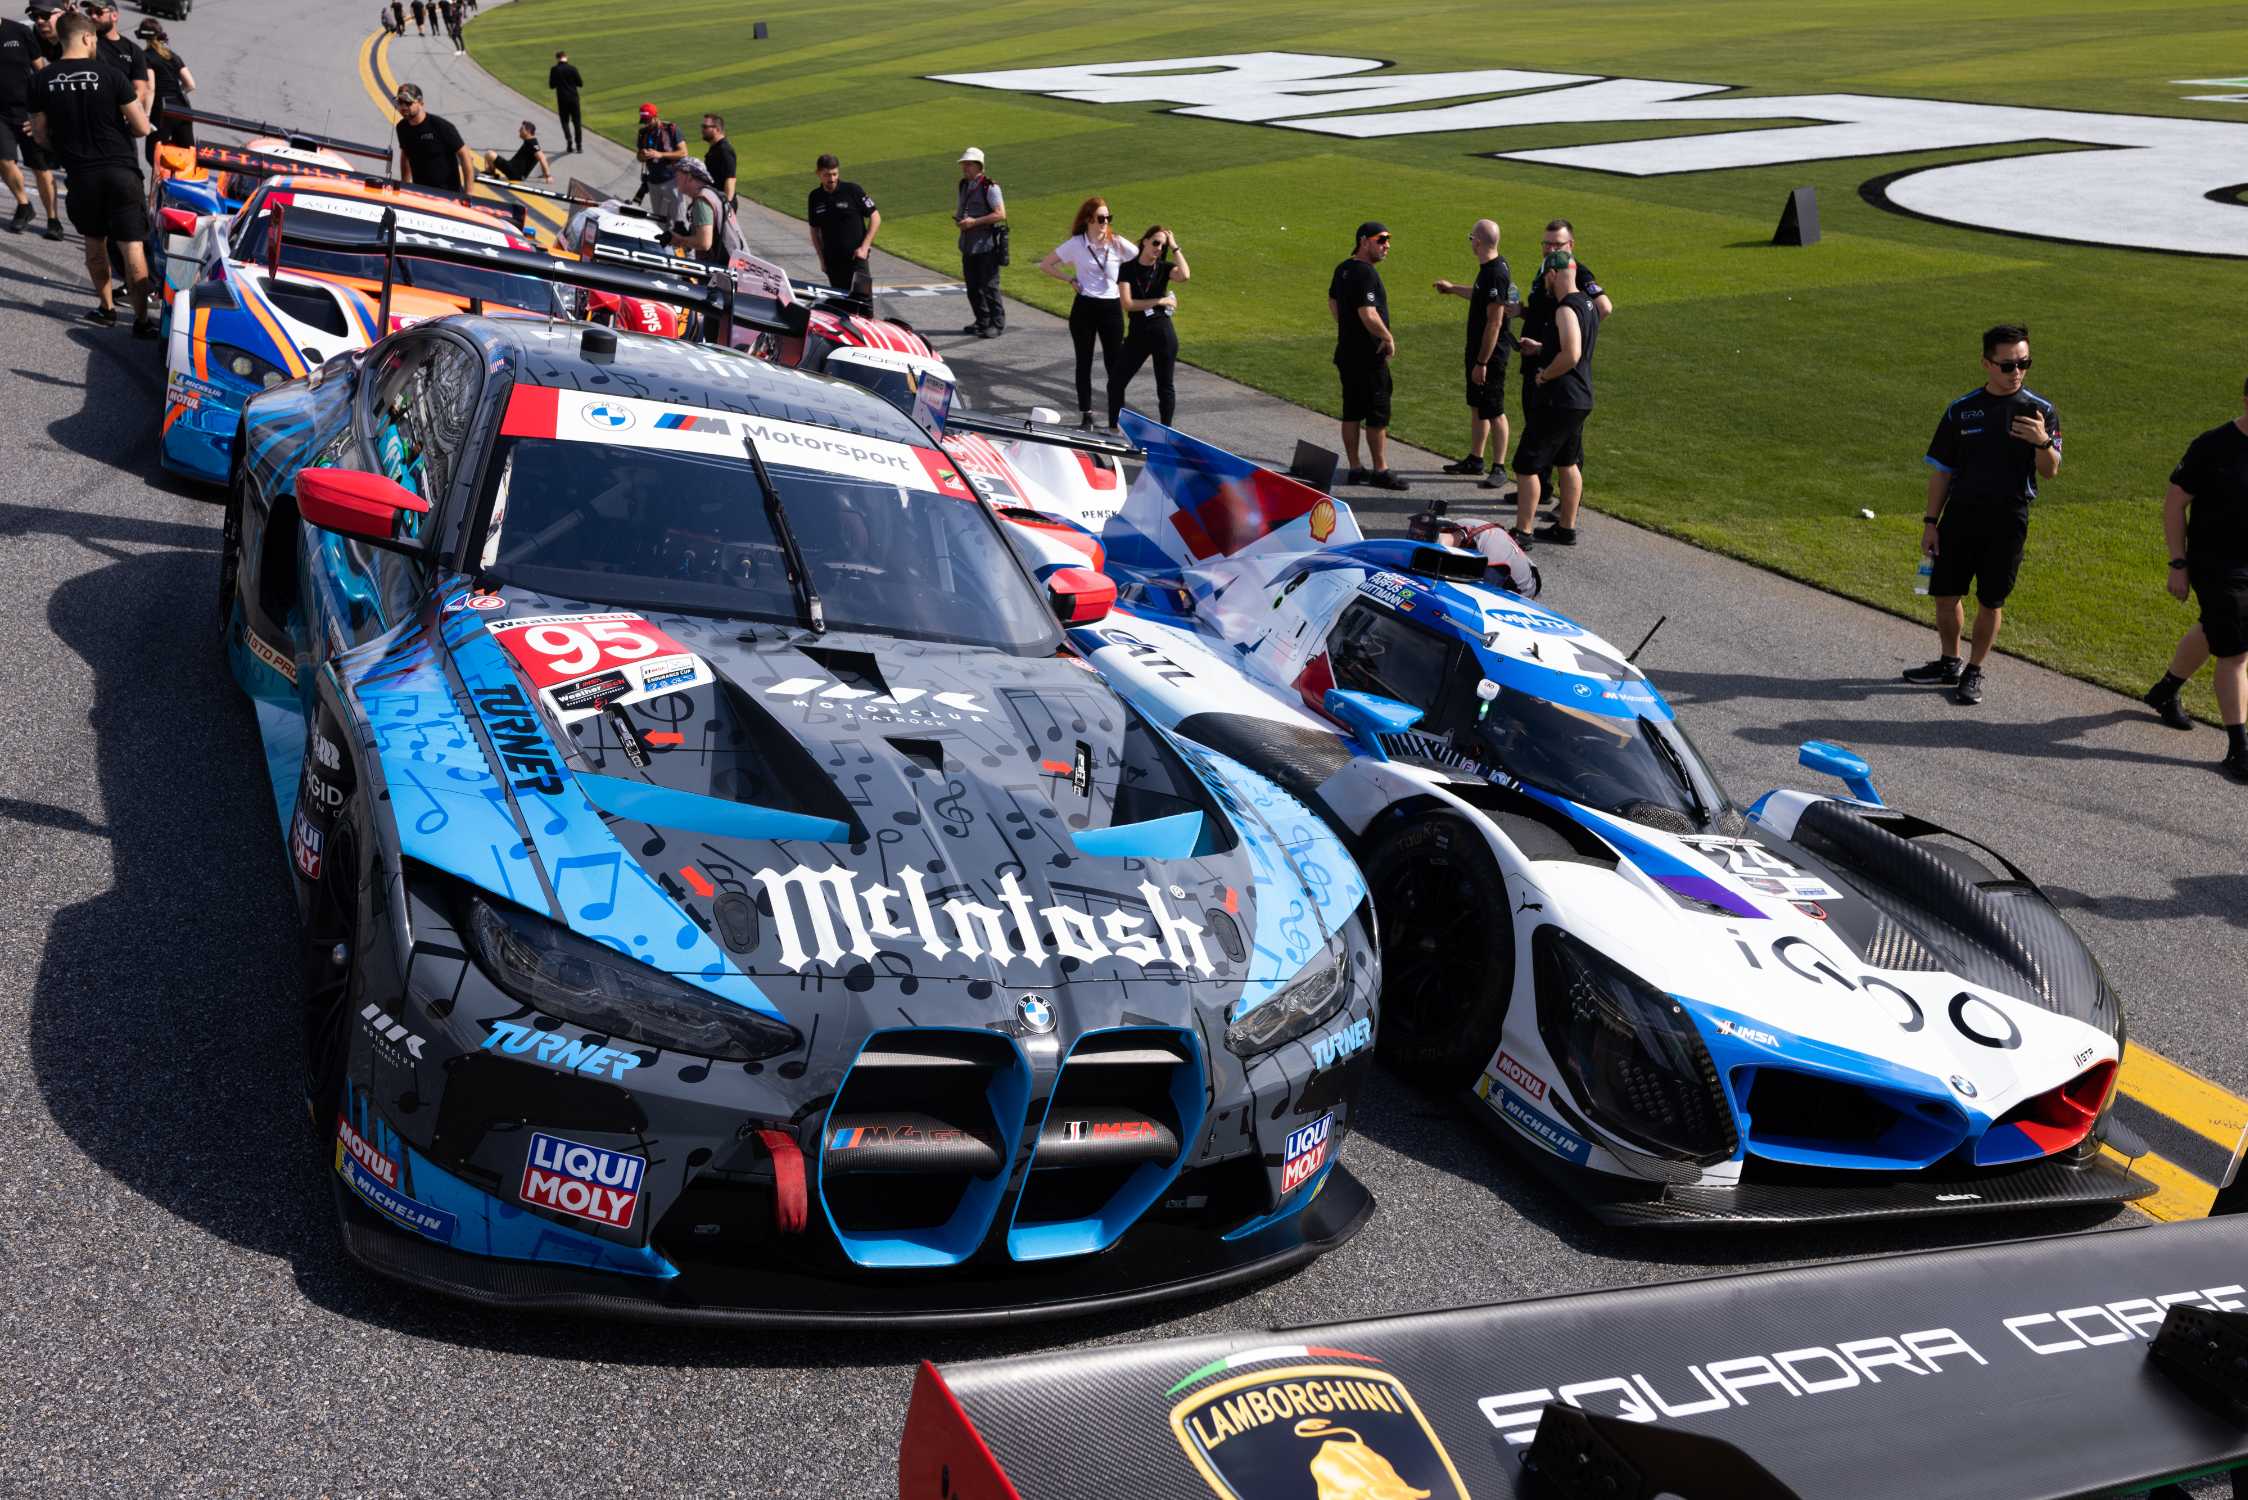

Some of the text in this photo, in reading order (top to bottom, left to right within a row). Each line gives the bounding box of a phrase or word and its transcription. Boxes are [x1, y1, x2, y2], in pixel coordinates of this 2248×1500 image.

[641, 302, 662, 332] nsys
[168, 390, 200, 409] MOTUL
[741, 422, 911, 472] Motorsport
[493, 612, 636, 629] WeatherTech
[524, 621, 659, 675] 95
[1100, 628, 1197, 688] CATL
[558, 678, 626, 703] WeatherTech
[792, 700, 984, 723] MOTORCLUB
[473, 683, 565, 796] TURNER
[846, 713, 948, 728] FLATROCK
[1698, 842, 1801, 877] 24
[752, 863, 1217, 979] McIntosh
[480, 1020, 641, 1081] TURNER
[1311, 1016, 1372, 1070] TURNER
[1736, 1024, 1781, 1048] IMSA
[1498, 1056, 1544, 1098] MOTUL
[339, 1119, 394, 1184] MOTUL
[1092, 1121, 1157, 1138] IMSA
[1287, 1116, 1331, 1161] LIQUI
[1505, 1100, 1579, 1153] MICHELIN
[533, 1138, 638, 1189] LIQUI
[1285, 1142, 1327, 1189] MOLY
[356, 1175, 442, 1230] MICHELIN
[526, 1170, 635, 1222] MOLY
[1477, 1327, 1989, 1446] SQUADRA
[1191, 1380, 1404, 1451] LAMBORGHINI
